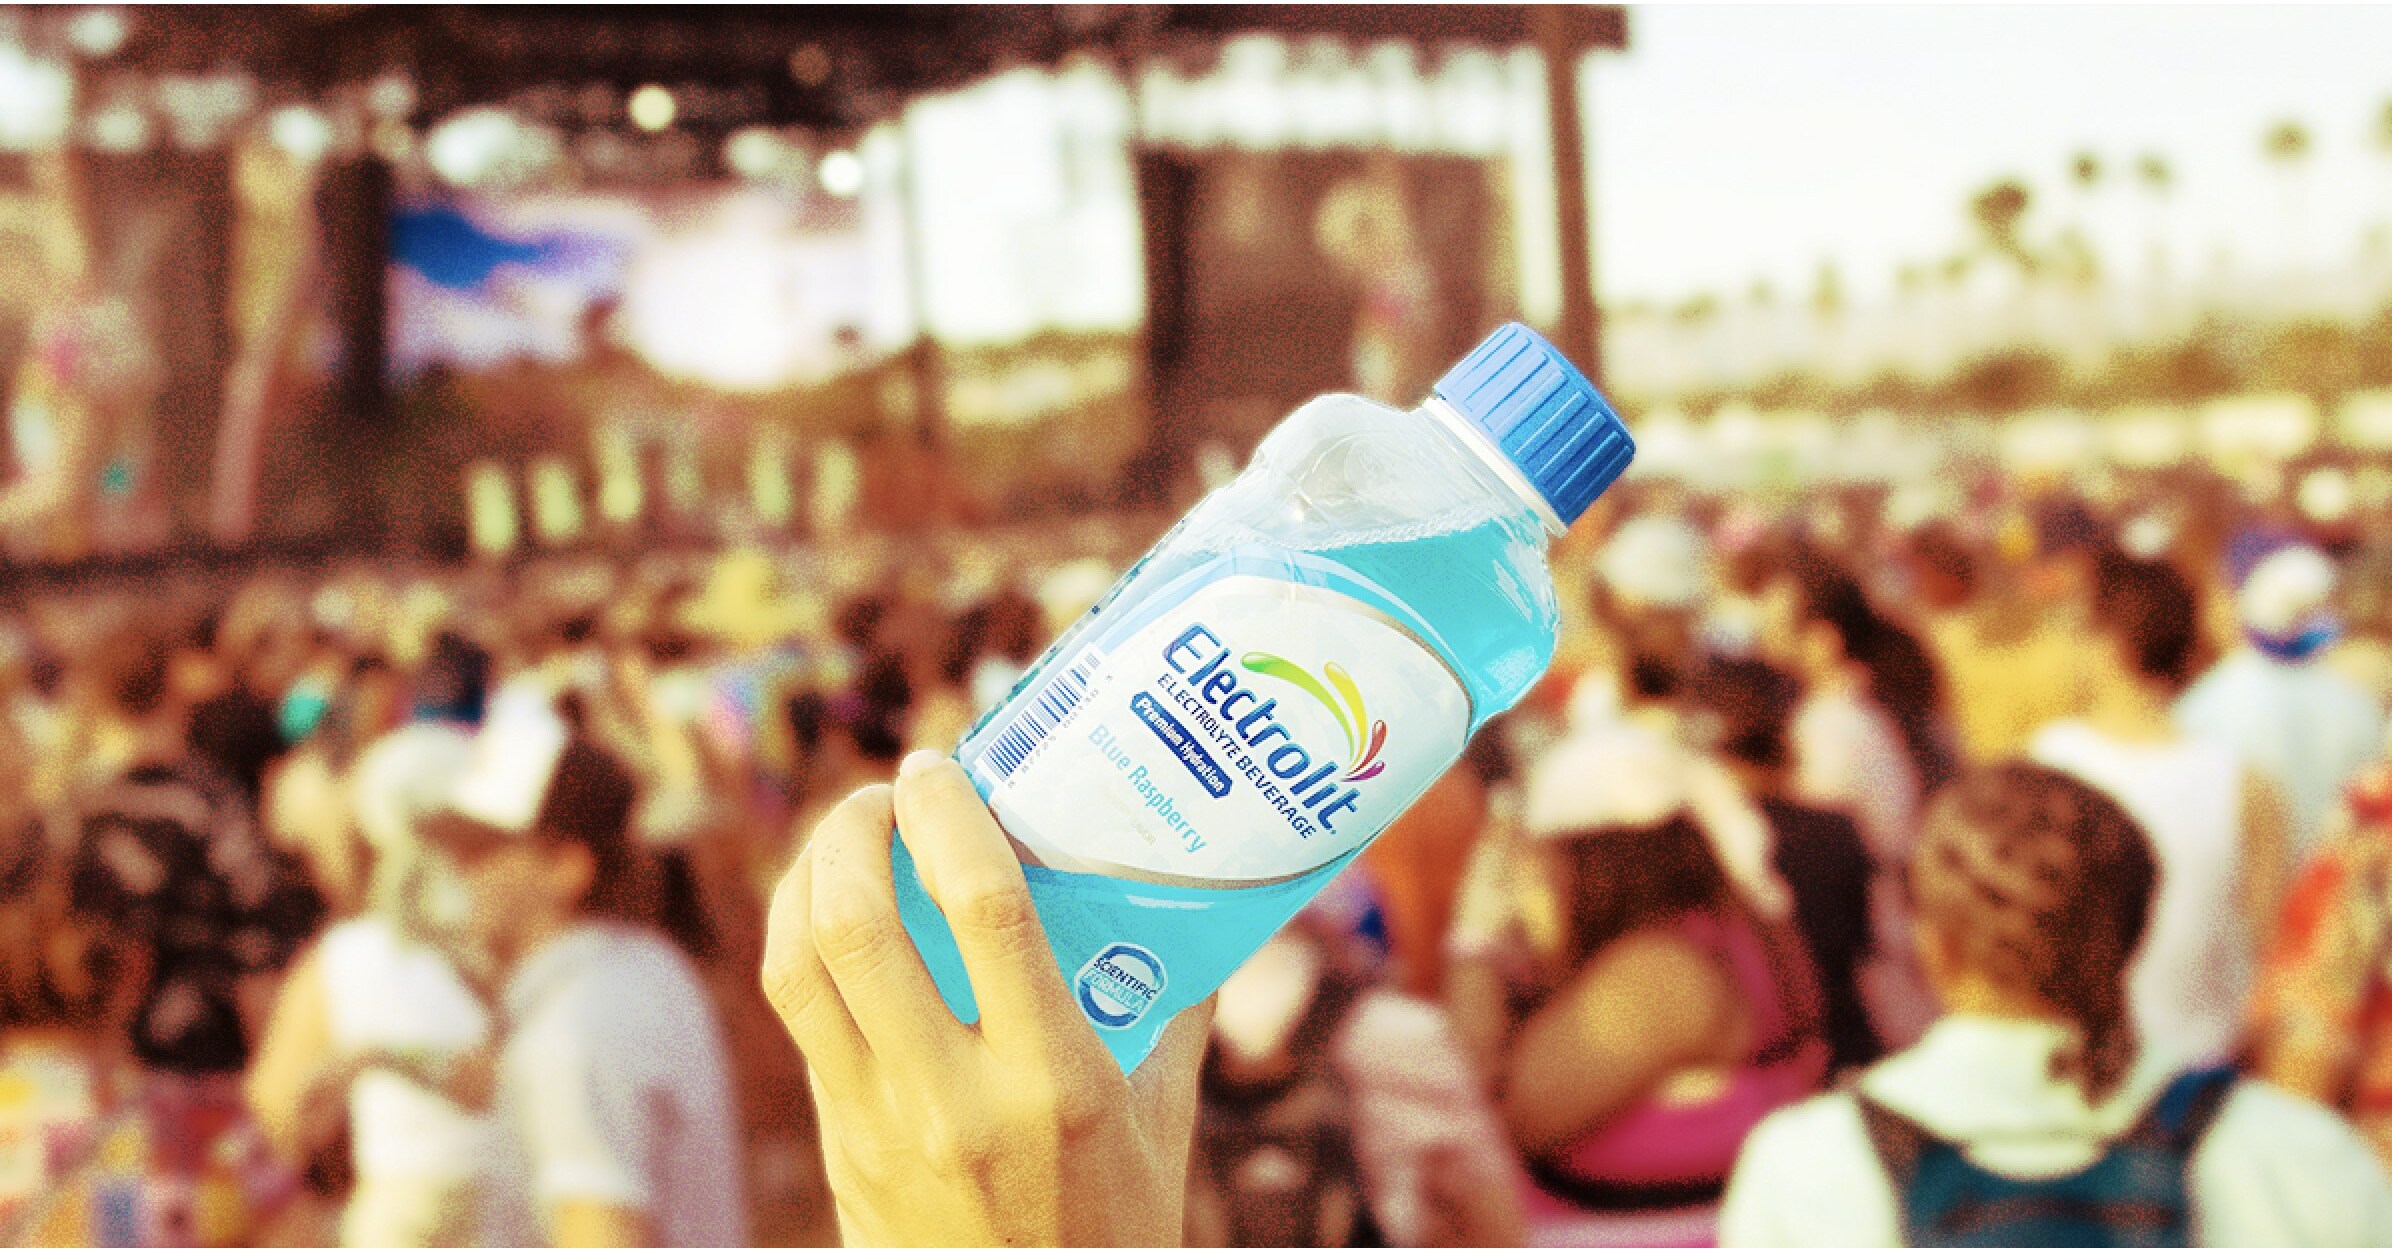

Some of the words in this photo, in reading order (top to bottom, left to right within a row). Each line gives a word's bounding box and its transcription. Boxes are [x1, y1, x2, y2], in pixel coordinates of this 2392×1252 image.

[1088, 724, 1131, 771] Blue
[1127, 764, 1208, 853] Raspberry
[1135, 697, 1183, 746] Premium
[1180, 741, 1225, 792] Hydration
[1157, 673, 1242, 758] ELECTROLYTE
[1236, 755, 1316, 839] BEVERAGE
[1162, 622, 1360, 832] Electrolit
[1093, 957, 1157, 1001] SCIENTIFIC
